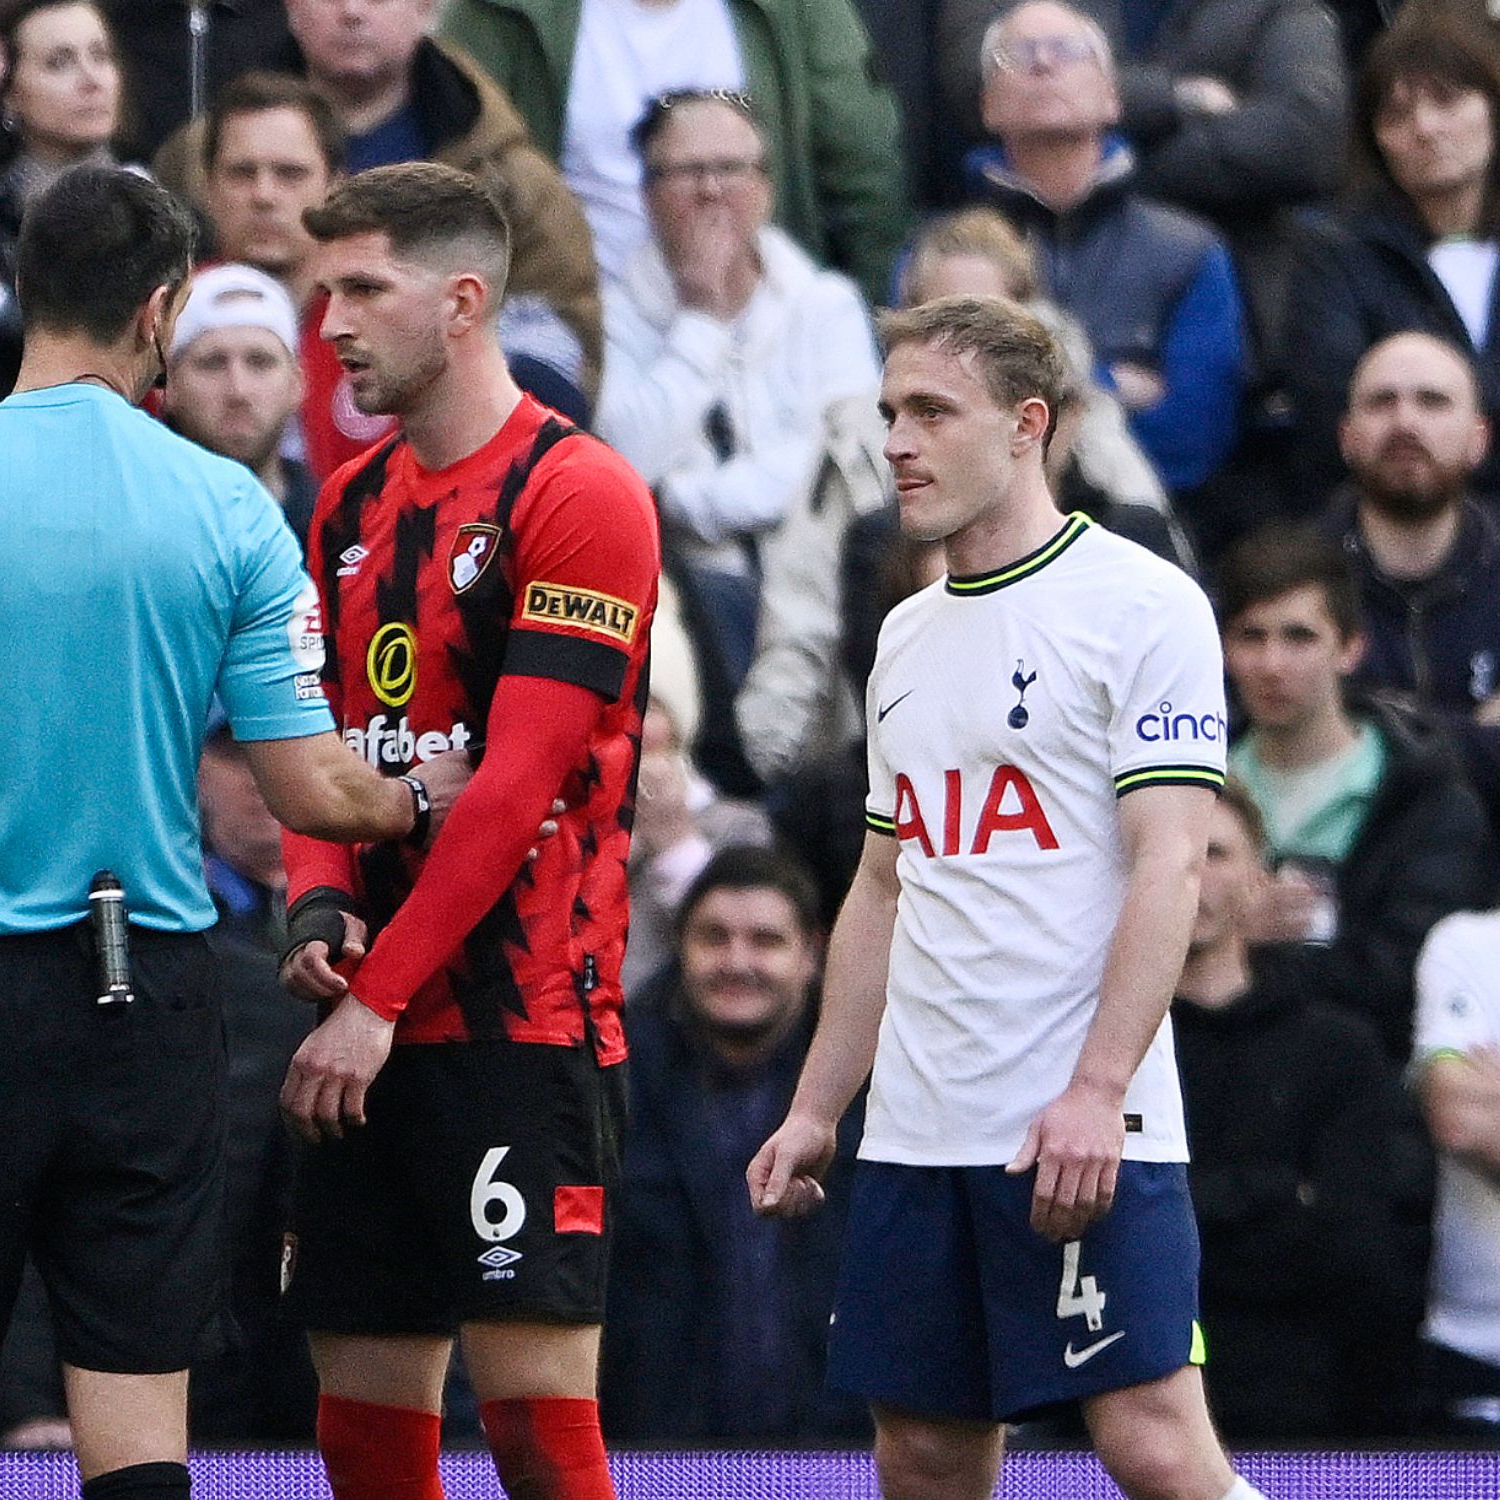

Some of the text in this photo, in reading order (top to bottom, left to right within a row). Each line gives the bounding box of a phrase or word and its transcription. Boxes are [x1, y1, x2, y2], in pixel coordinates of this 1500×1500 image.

[343, 714, 470, 770] afabet
[895, 764, 1060, 858] AIA
[470, 1146, 526, 1241] 6
[482, 1269, 515, 1281] umbro
[1057, 1241, 1106, 1332] 4
